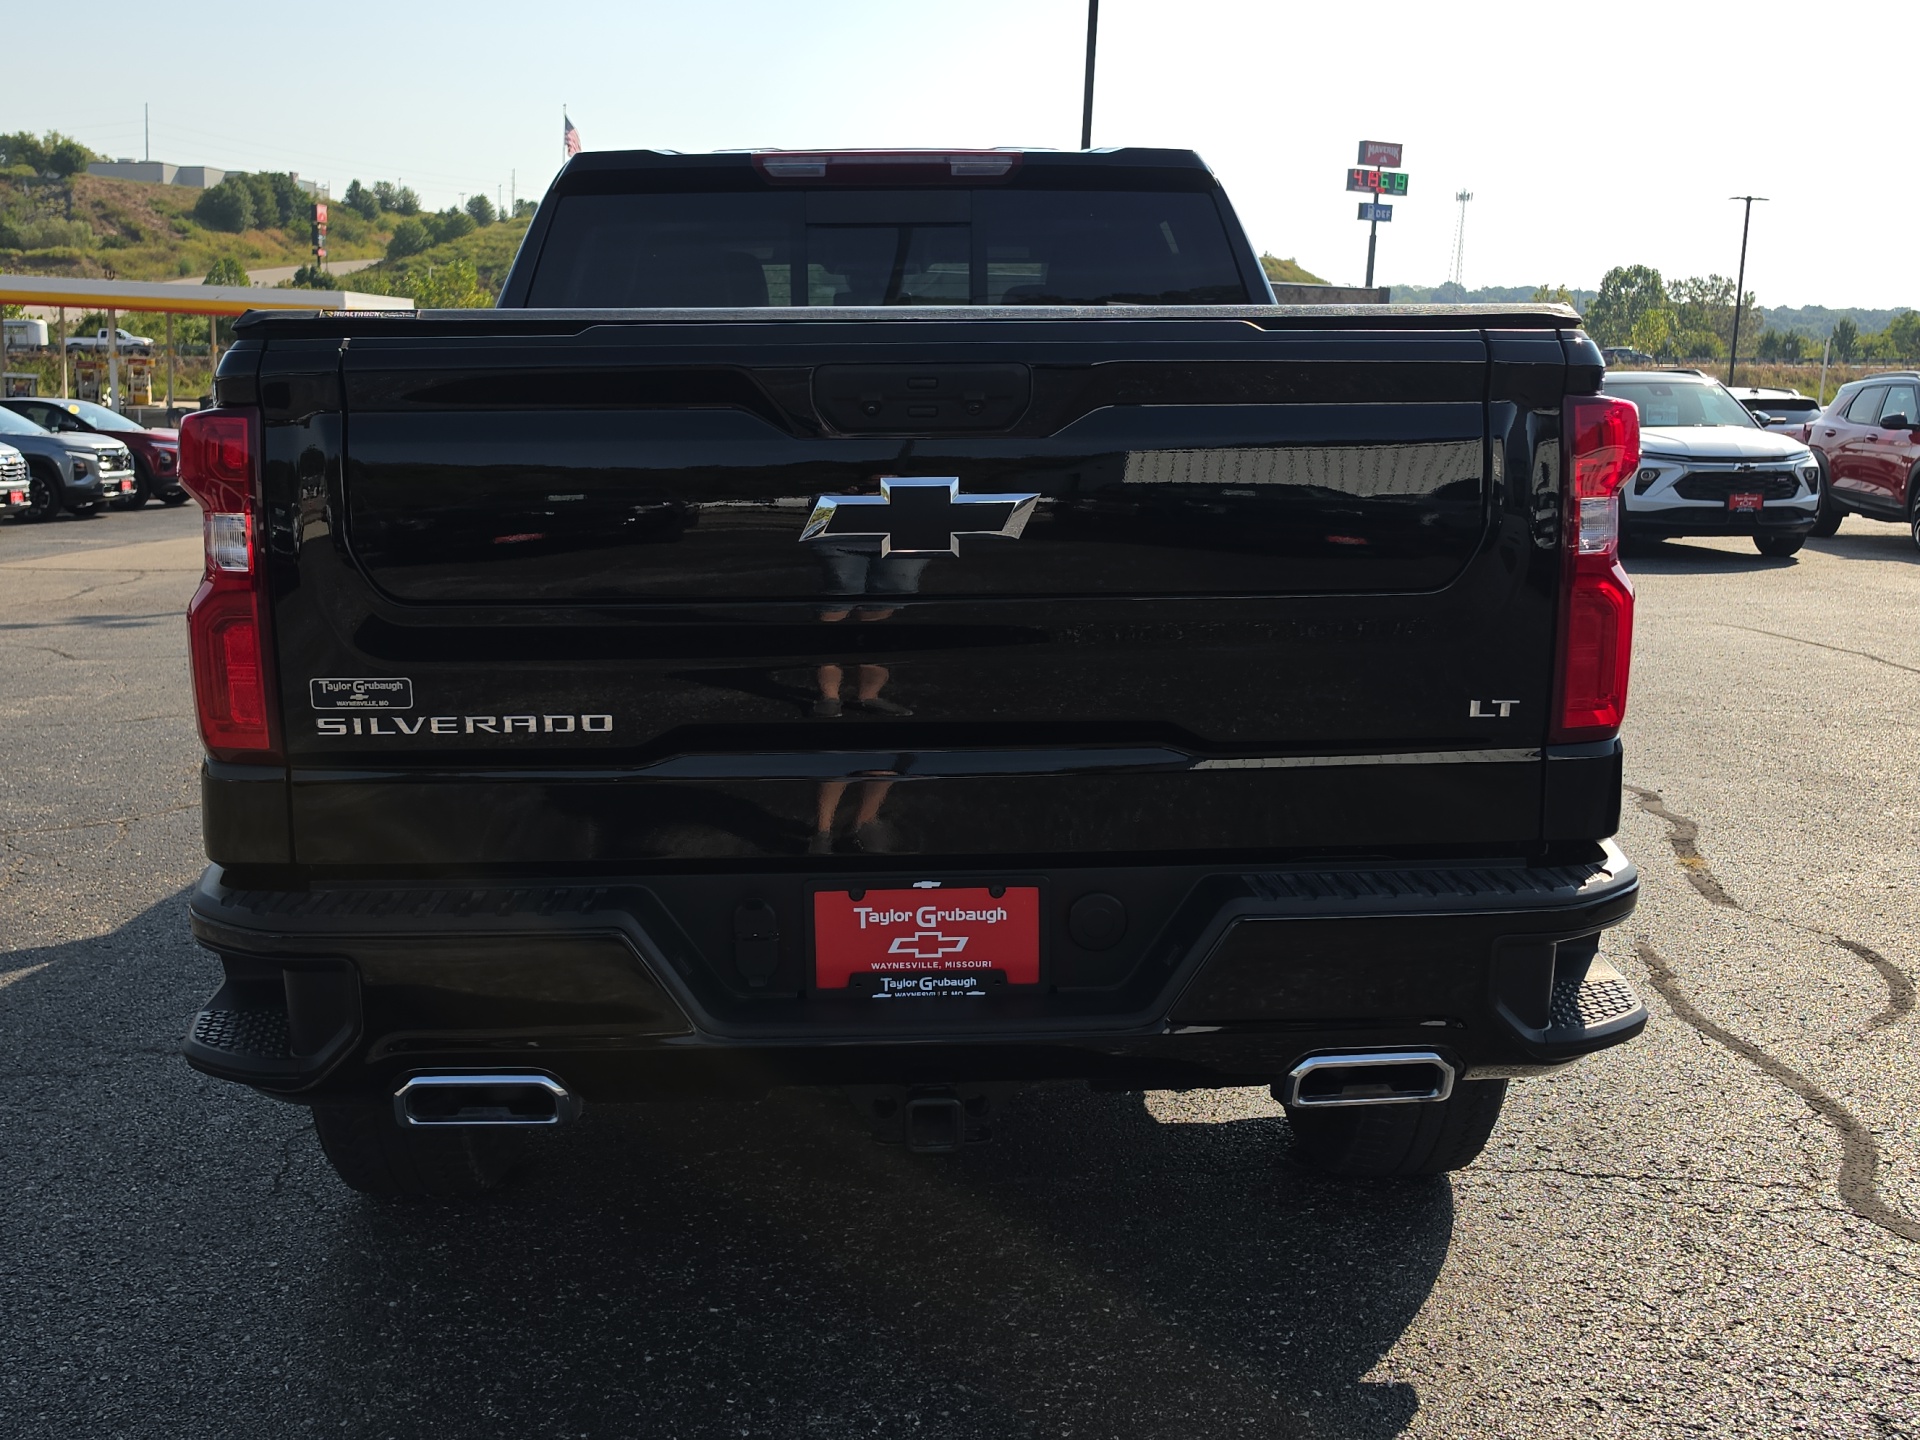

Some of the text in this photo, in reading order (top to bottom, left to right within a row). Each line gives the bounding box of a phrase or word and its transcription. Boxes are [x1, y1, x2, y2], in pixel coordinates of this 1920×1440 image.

[1367, 144, 1400, 160] MAVERIK
[1375, 209, 1391, 218] DEF
[318, 681, 403, 693] Taylor Grubaugh
[1469, 699, 1520, 717] LT
[316, 714, 613, 735] SILVERADO
[853, 906, 1007, 929] Taylor Grubaugh
[871, 962, 942, 970] WAYNESVILLE,
[880, 976, 977, 992] Taylor Grubaugh
